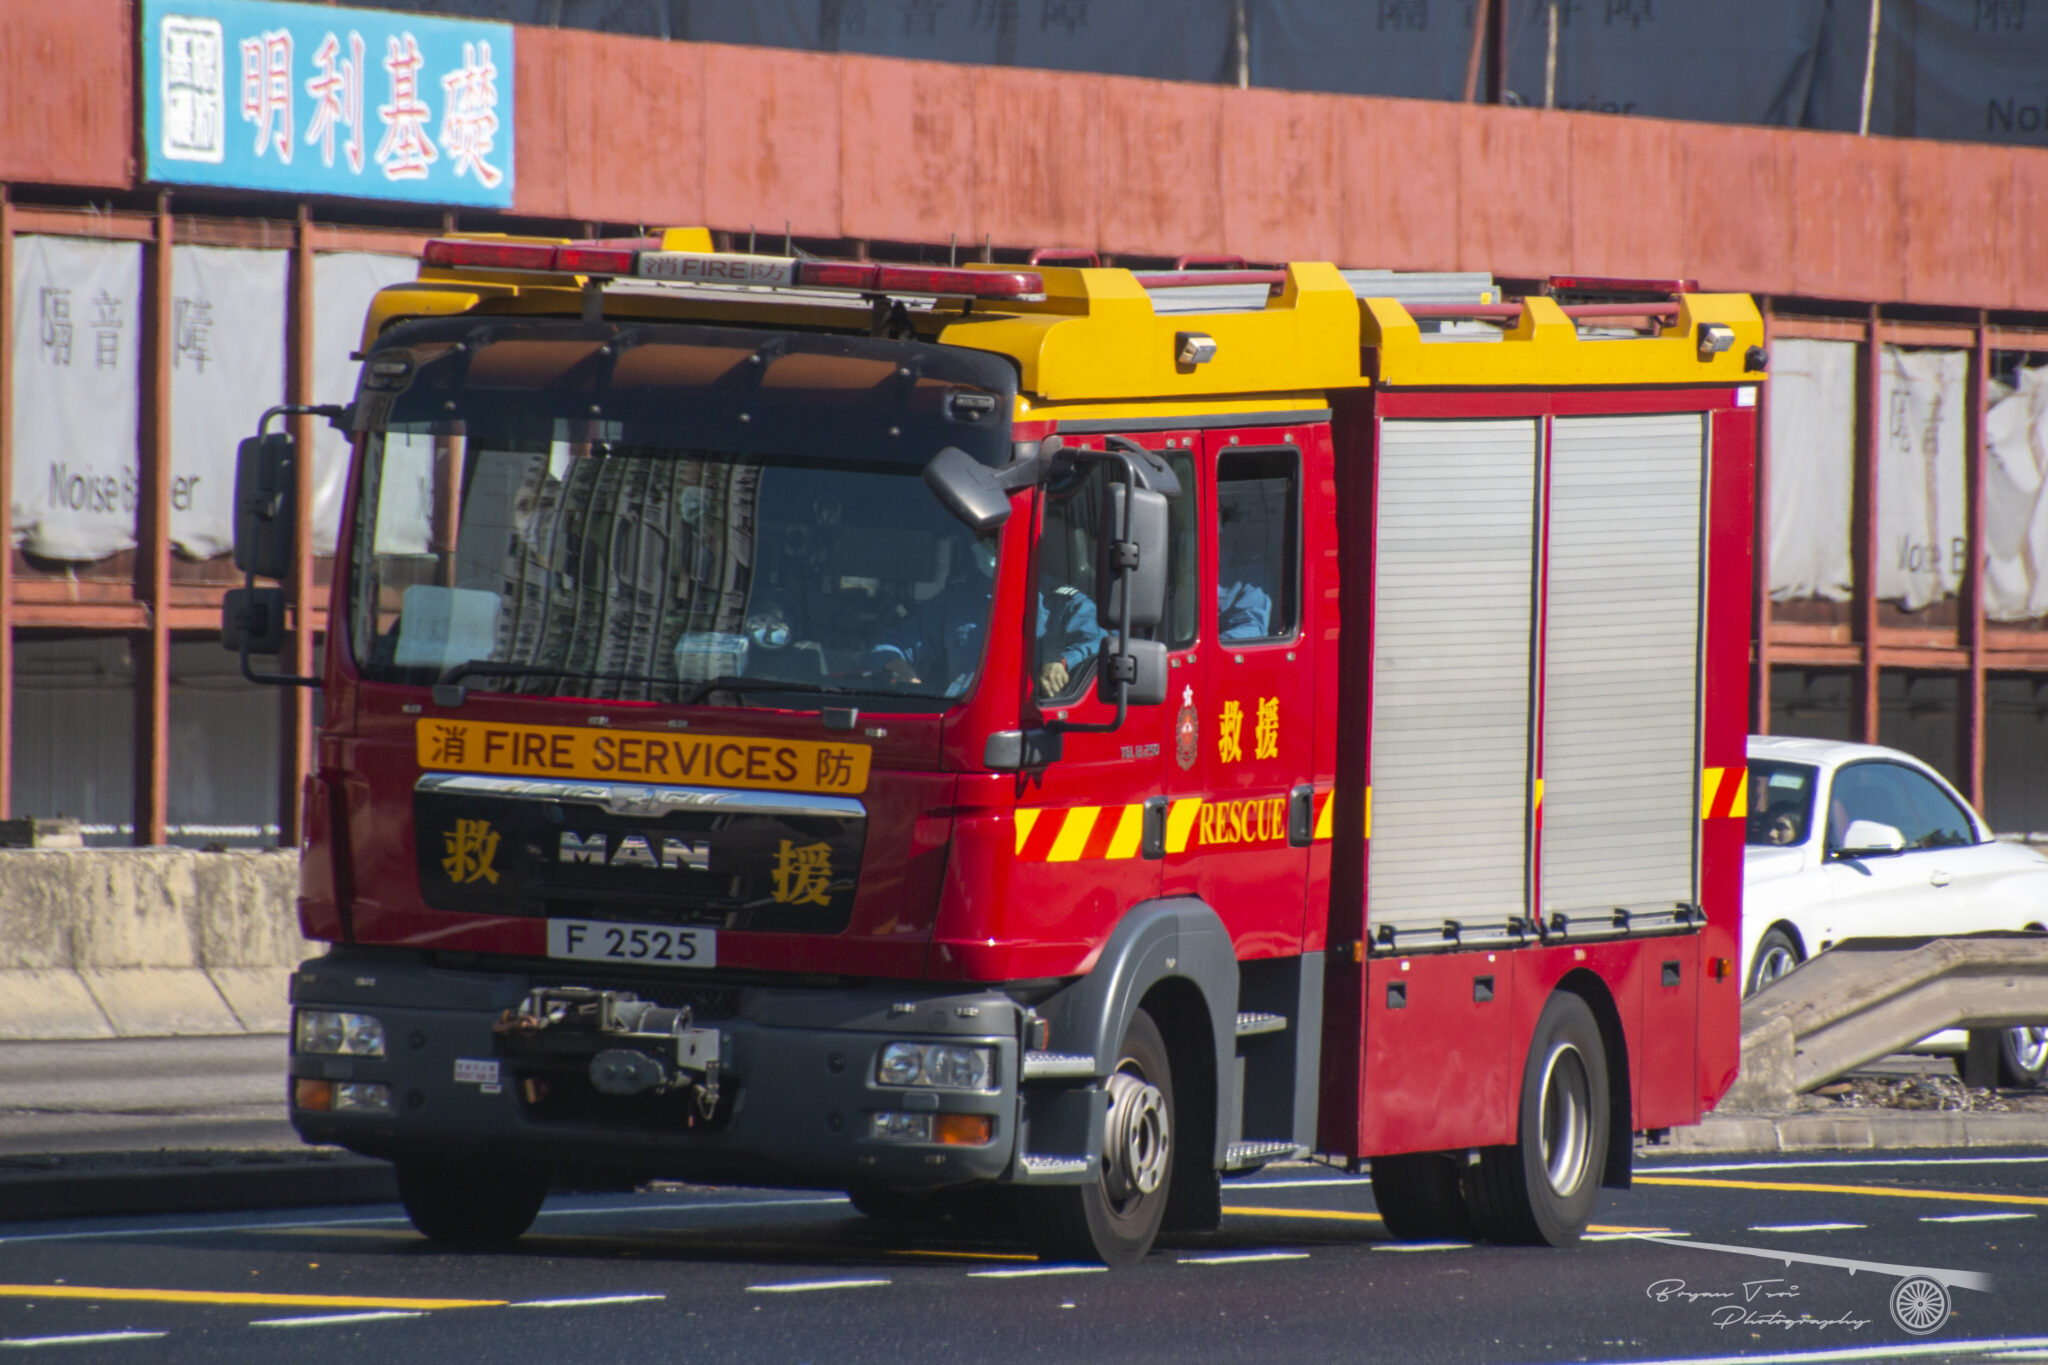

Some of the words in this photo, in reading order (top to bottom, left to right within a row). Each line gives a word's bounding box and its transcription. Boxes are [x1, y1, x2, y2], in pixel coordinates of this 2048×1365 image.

[240, 27, 503, 188] 明利基礎
[681, 258, 747, 279] FIRE
[431, 725, 467, 764] 消
[484, 730, 575, 769] FIRE
[592, 737, 799, 782] SERVICES
[815, 748, 854, 787] 防
[1218, 696, 1280, 764] 救援
[441, 818, 501, 885] 救
[559, 831, 710, 871] MAN
[1199, 798, 1286, 845] RESCUE
[771, 839, 834, 907] 援
[566, 925, 588, 954] F
[605, 928, 698, 961] 2525
